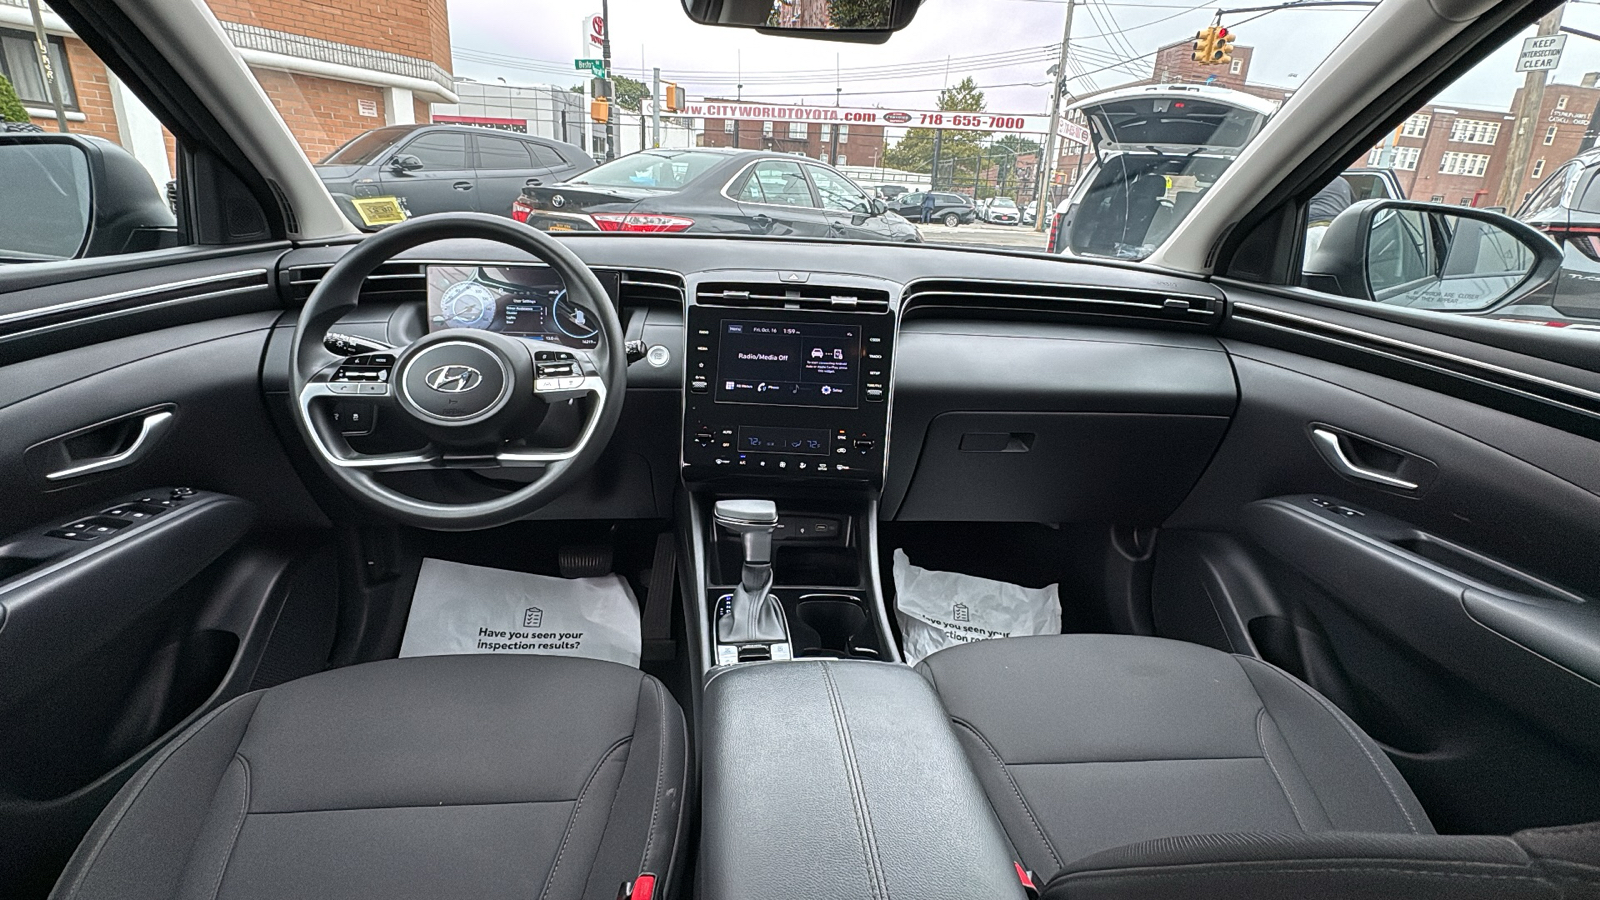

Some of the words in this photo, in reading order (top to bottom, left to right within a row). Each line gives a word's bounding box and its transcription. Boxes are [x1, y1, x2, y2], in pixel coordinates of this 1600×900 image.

[1532, 39, 1556, 48] KEEP
[1521, 49, 1561, 58] INTERSECTION
[1524, 59, 1552, 68] CLEAR
[943, 621, 961, 630] you
[963, 625, 985, 635] seen
[478, 627, 506, 638] Have
[508, 631, 529, 640] you
[477, 640, 536, 651] inspection
